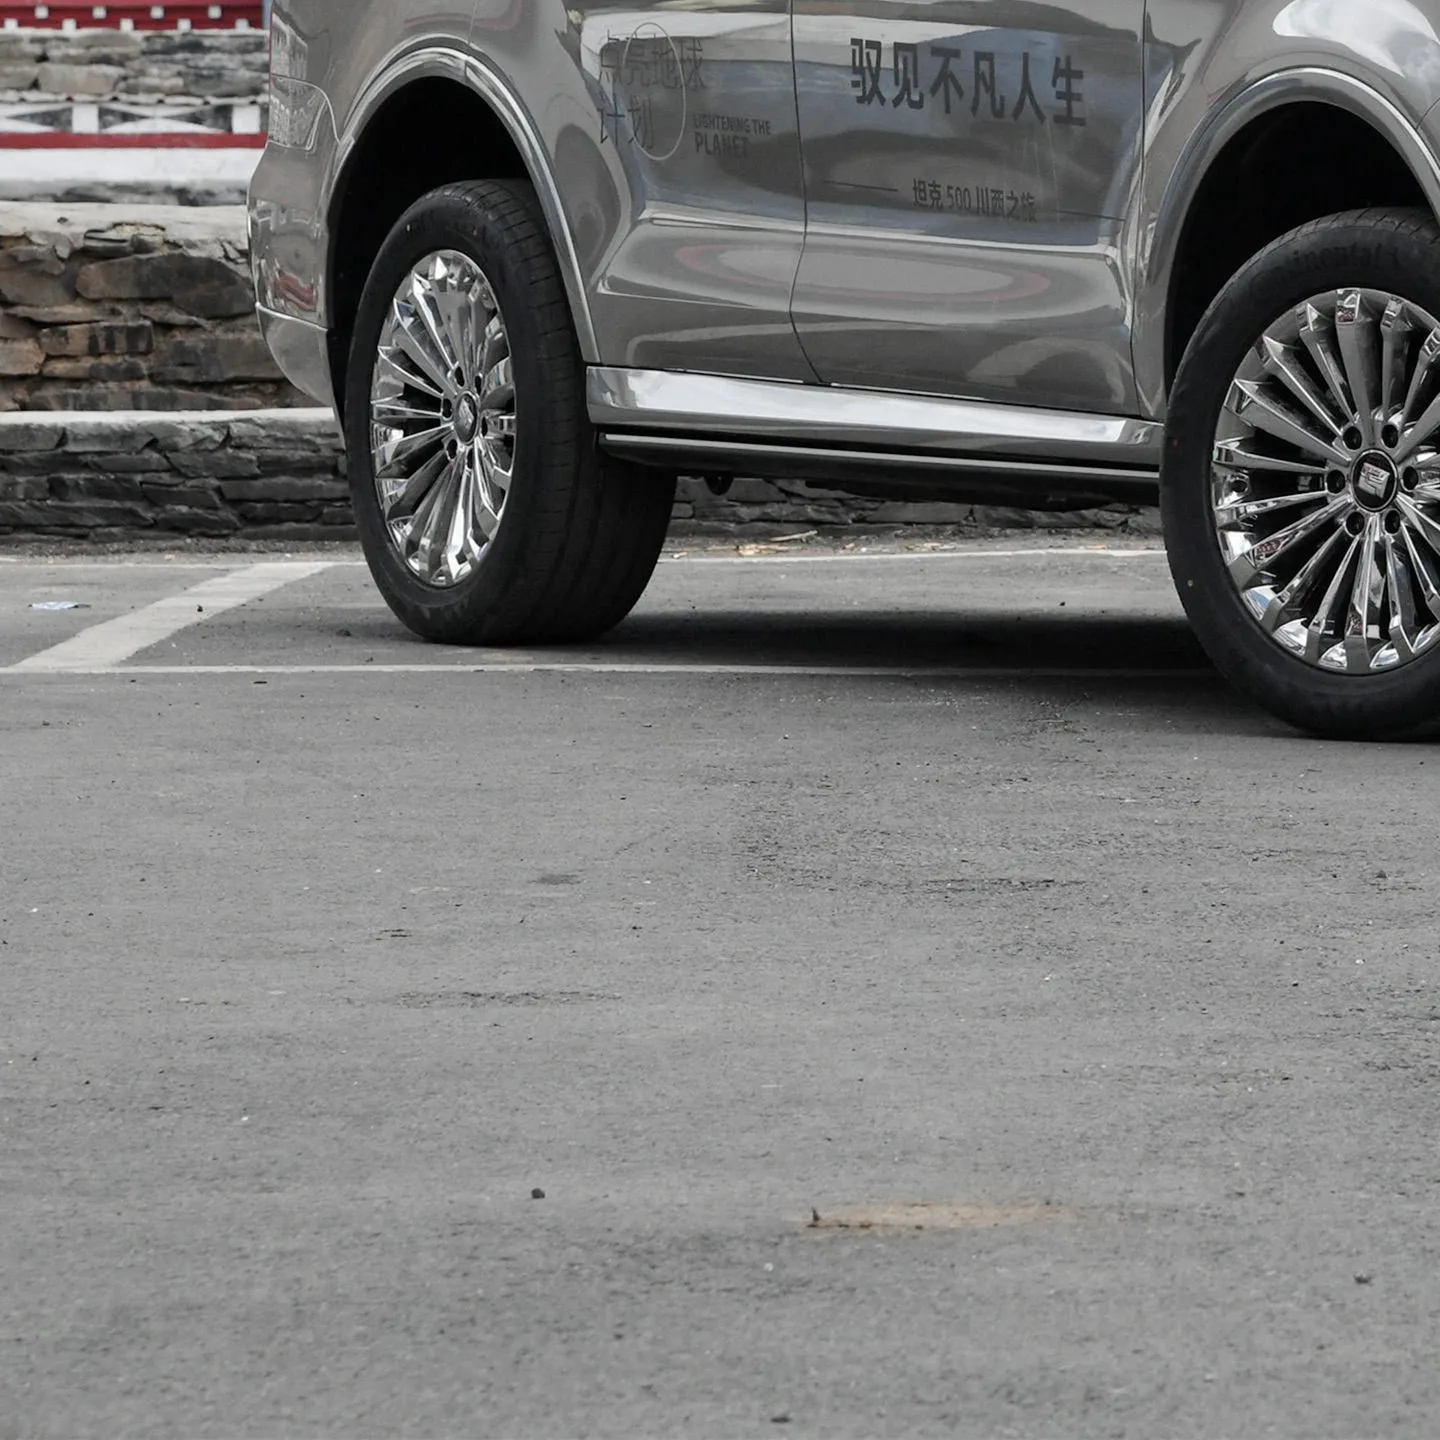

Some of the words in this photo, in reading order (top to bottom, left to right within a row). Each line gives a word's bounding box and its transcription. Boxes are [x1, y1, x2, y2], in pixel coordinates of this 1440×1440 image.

[850, 37, 1087, 127] 驭见不凡人生
[751, 118, 772, 135] THE
